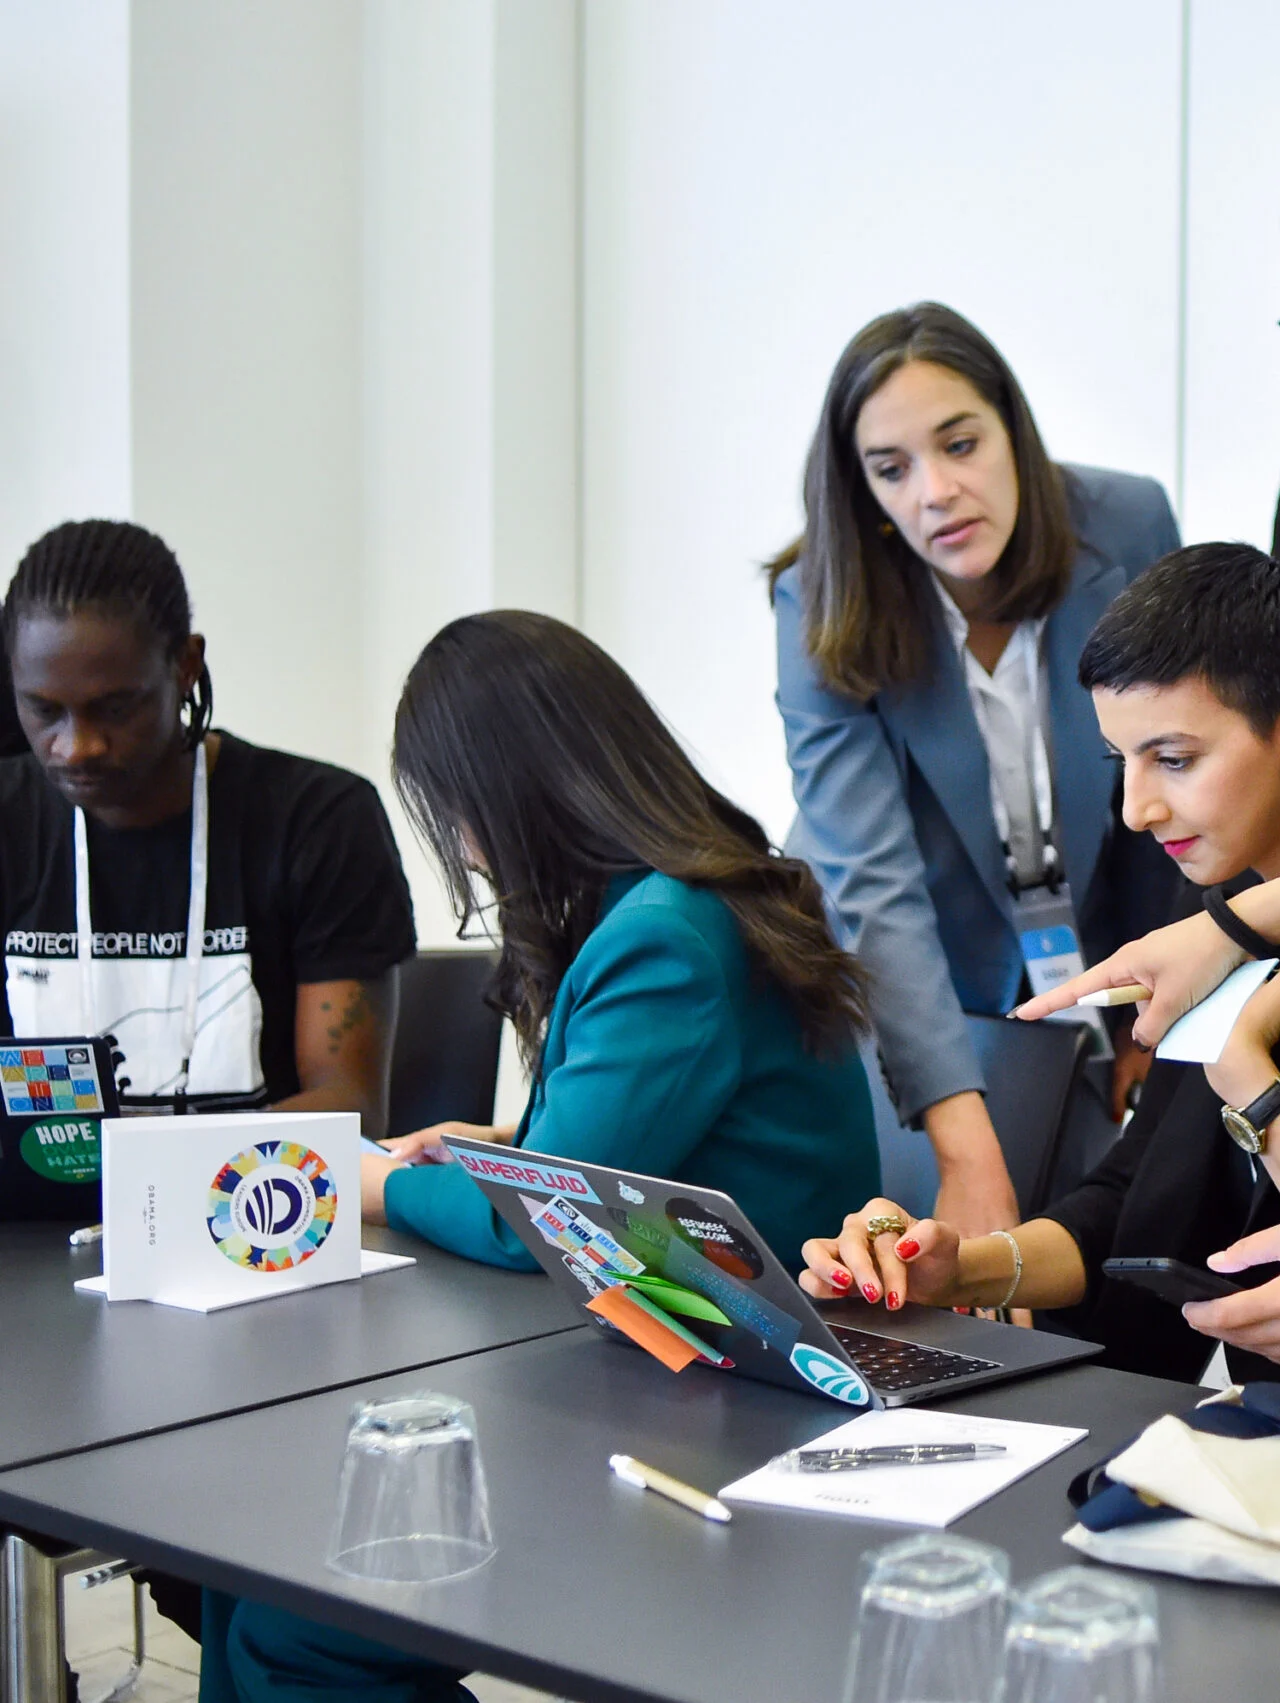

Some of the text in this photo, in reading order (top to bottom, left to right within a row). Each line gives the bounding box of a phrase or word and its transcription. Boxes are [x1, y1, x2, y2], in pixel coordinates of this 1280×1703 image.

[6, 930, 78, 955] PROTECT
[92, 931, 148, 955] EOPLE
[150, 931, 186, 956] NOT
[35, 1122, 96, 1145] HOPE
[459, 1154, 588, 1195] SUPERFLUID
[148, 1185, 156, 1246] OBAMA.ORG
[677, 1217, 727, 1233] REFUGEES
[687, 1227, 734, 1244] WELCOME
